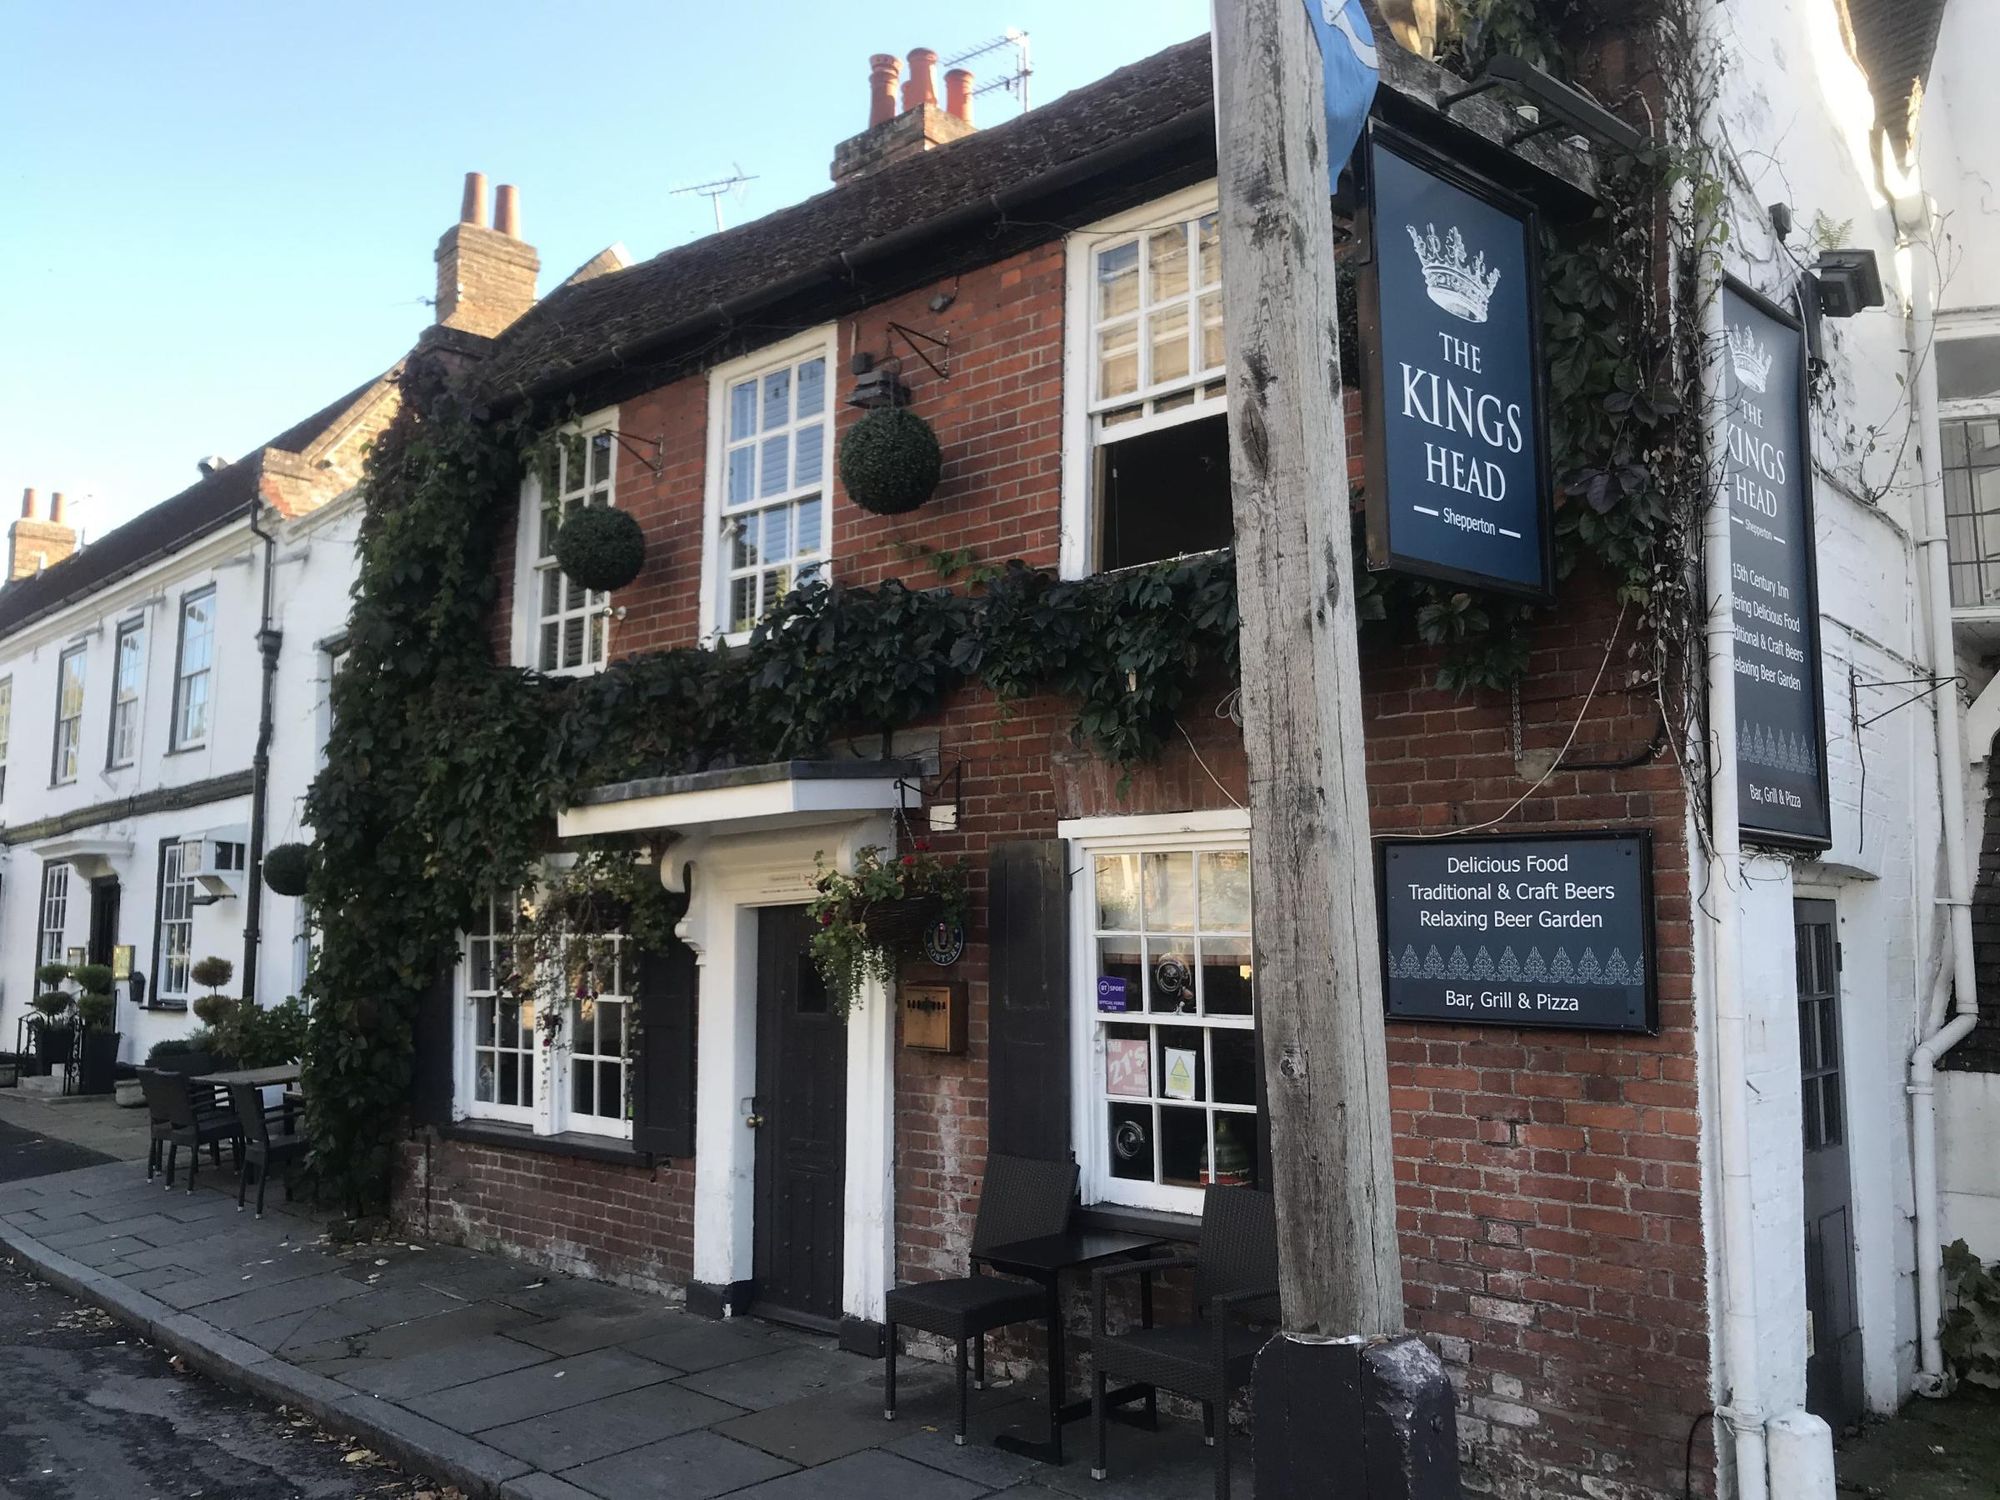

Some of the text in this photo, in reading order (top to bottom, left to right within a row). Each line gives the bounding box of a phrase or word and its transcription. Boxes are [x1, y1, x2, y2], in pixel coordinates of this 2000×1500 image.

[1438, 331, 1482, 374] THE
[1399, 362, 1523, 453] KINGS
[1741, 398, 1763, 428] THE
[1423, 442, 1506, 502] HEAD
[1735, 472, 1777, 518] HEAD
[1443, 507, 1496, 536] Shepperton
[1744, 518, 1773, 541] Shepperton
[1732, 562, 1790, 600] 15th Century Inn
[1753, 600, 1783, 627] Delicious
[1784, 612, 1800, 633] Food
[1734, 624, 1804, 663] ditional & Craft Beers
[1734, 655, 1801, 691] elaxing Beer Garden
[1749, 783, 1801, 808] Bar, Grill & Pizza
[1447, 854, 1569, 874] Delicious Food
[1408, 882, 1615, 900] Traditional & Craft Beers
[1420, 910, 1603, 931] Relaxing Beer Garden
[1446, 990, 1579, 1011] Bar, Grill & Pizza
